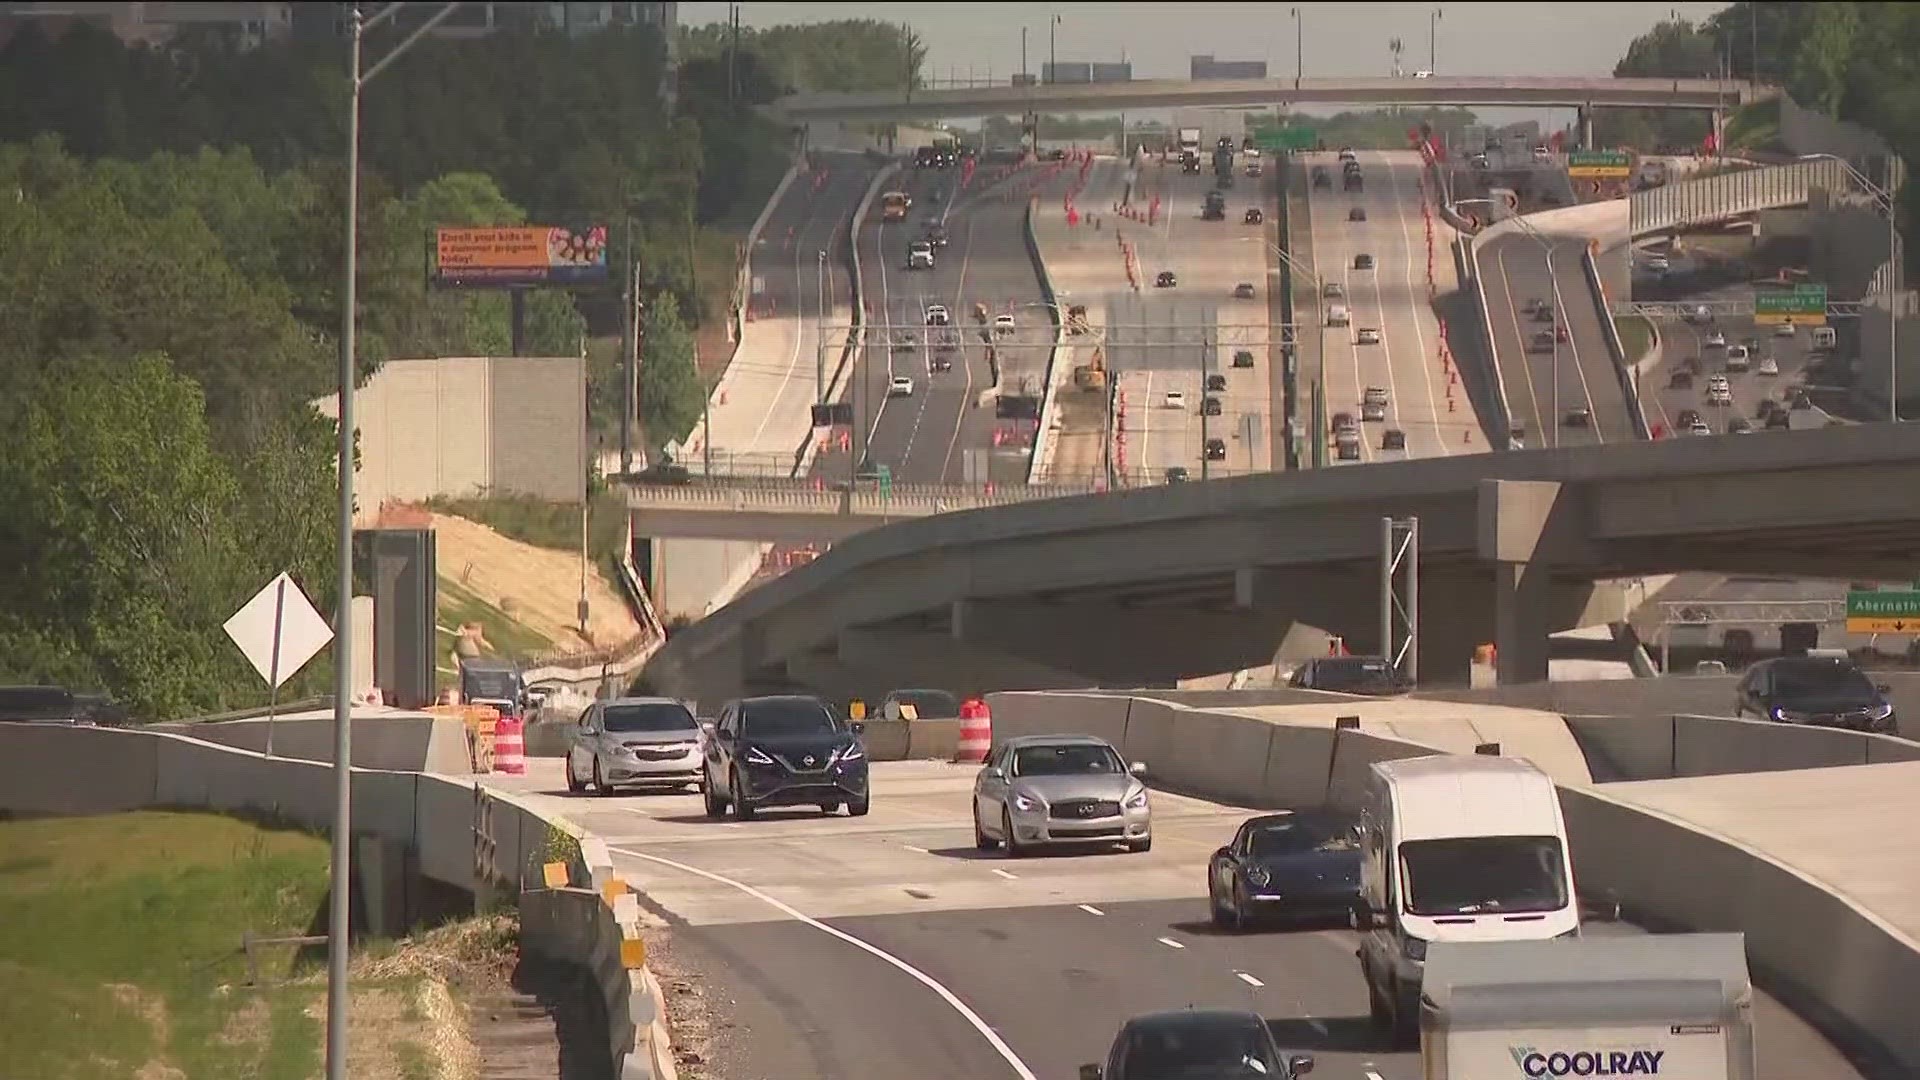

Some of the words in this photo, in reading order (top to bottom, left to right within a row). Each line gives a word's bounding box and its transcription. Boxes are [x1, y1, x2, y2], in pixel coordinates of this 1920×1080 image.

[474, 233, 497, 244] your
[498, 232, 520, 242] kids
[450, 245, 492, 253] summer
[494, 244, 539, 254] program
[1855, 599, 1920, 612] Abernath
[1523, 1049, 1665, 1078] COOLRAY
